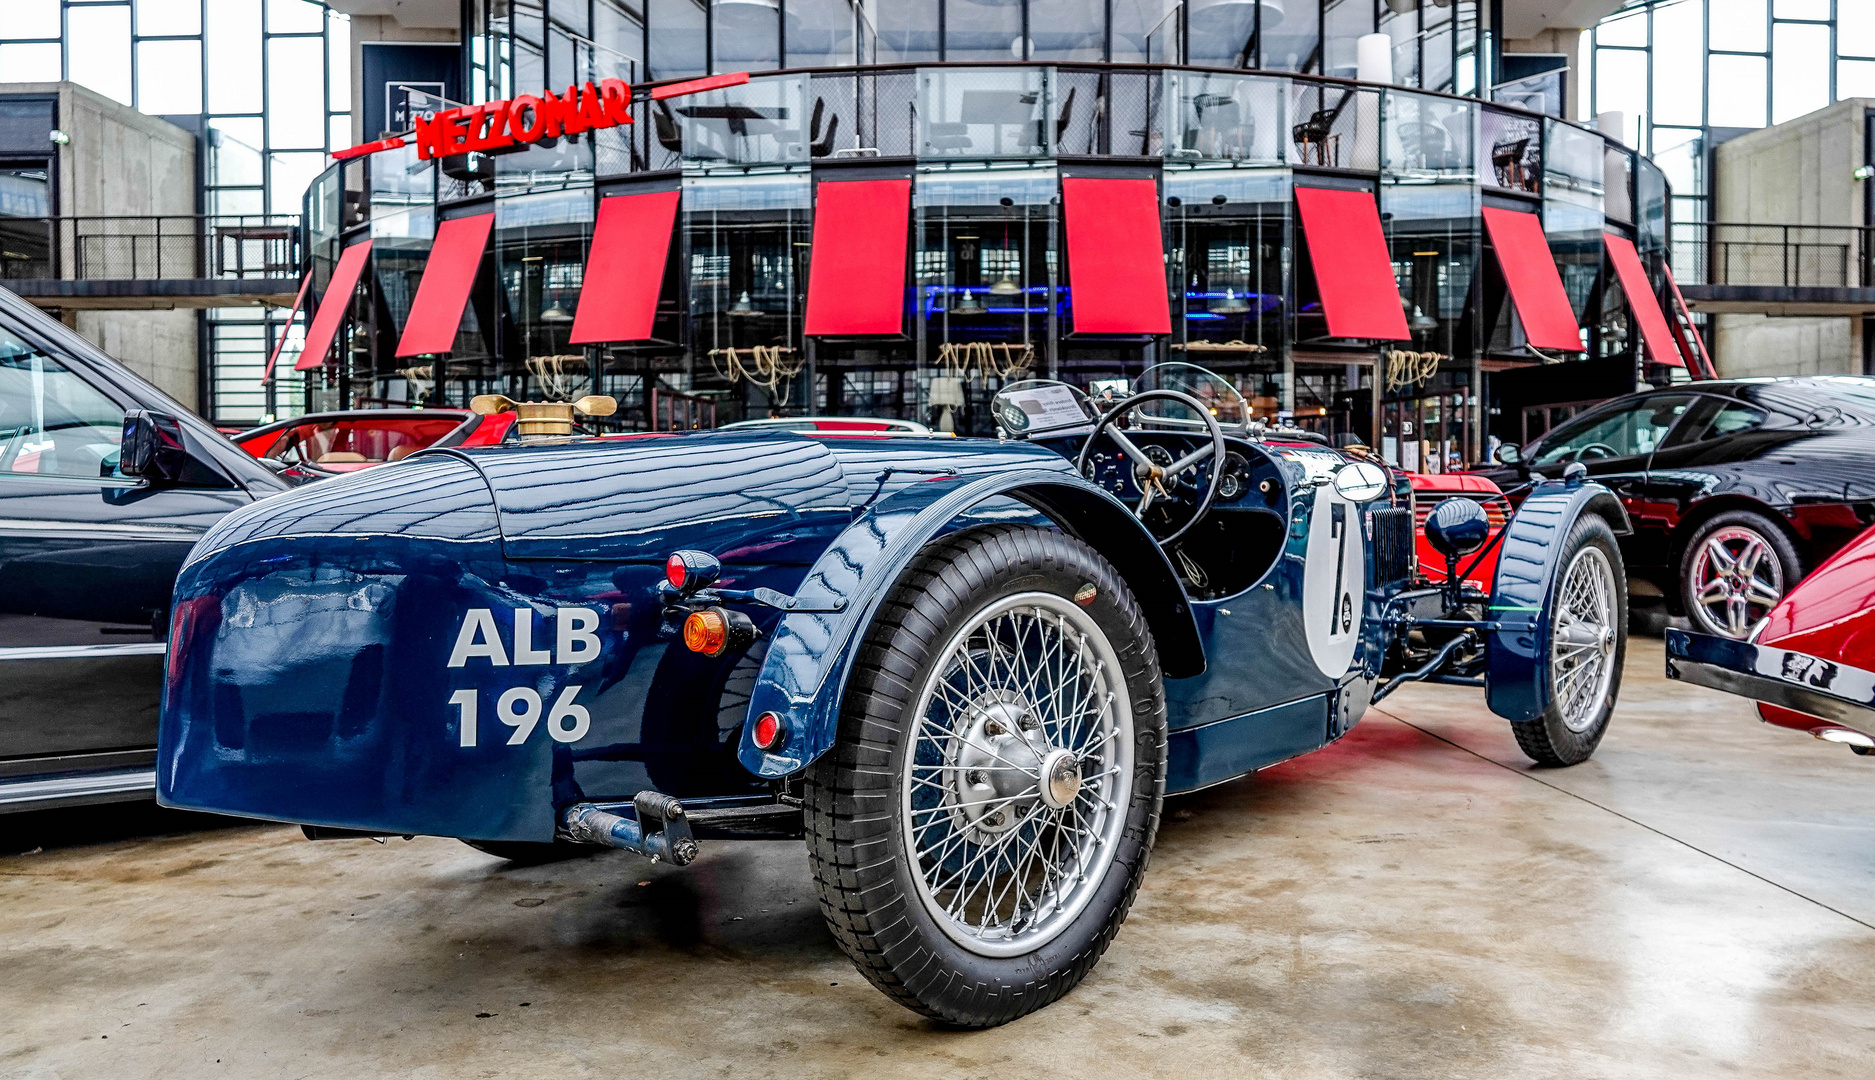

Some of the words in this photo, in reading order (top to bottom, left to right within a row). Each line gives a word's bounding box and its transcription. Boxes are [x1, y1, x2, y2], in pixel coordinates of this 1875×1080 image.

[415, 78, 635, 160] MEZZOMAR
[1331, 503, 1346, 636] 7
[447, 608, 601, 668] ALB
[448, 685, 591, 747] 196
[1115, 640, 1156, 873] BLOCKLEY
